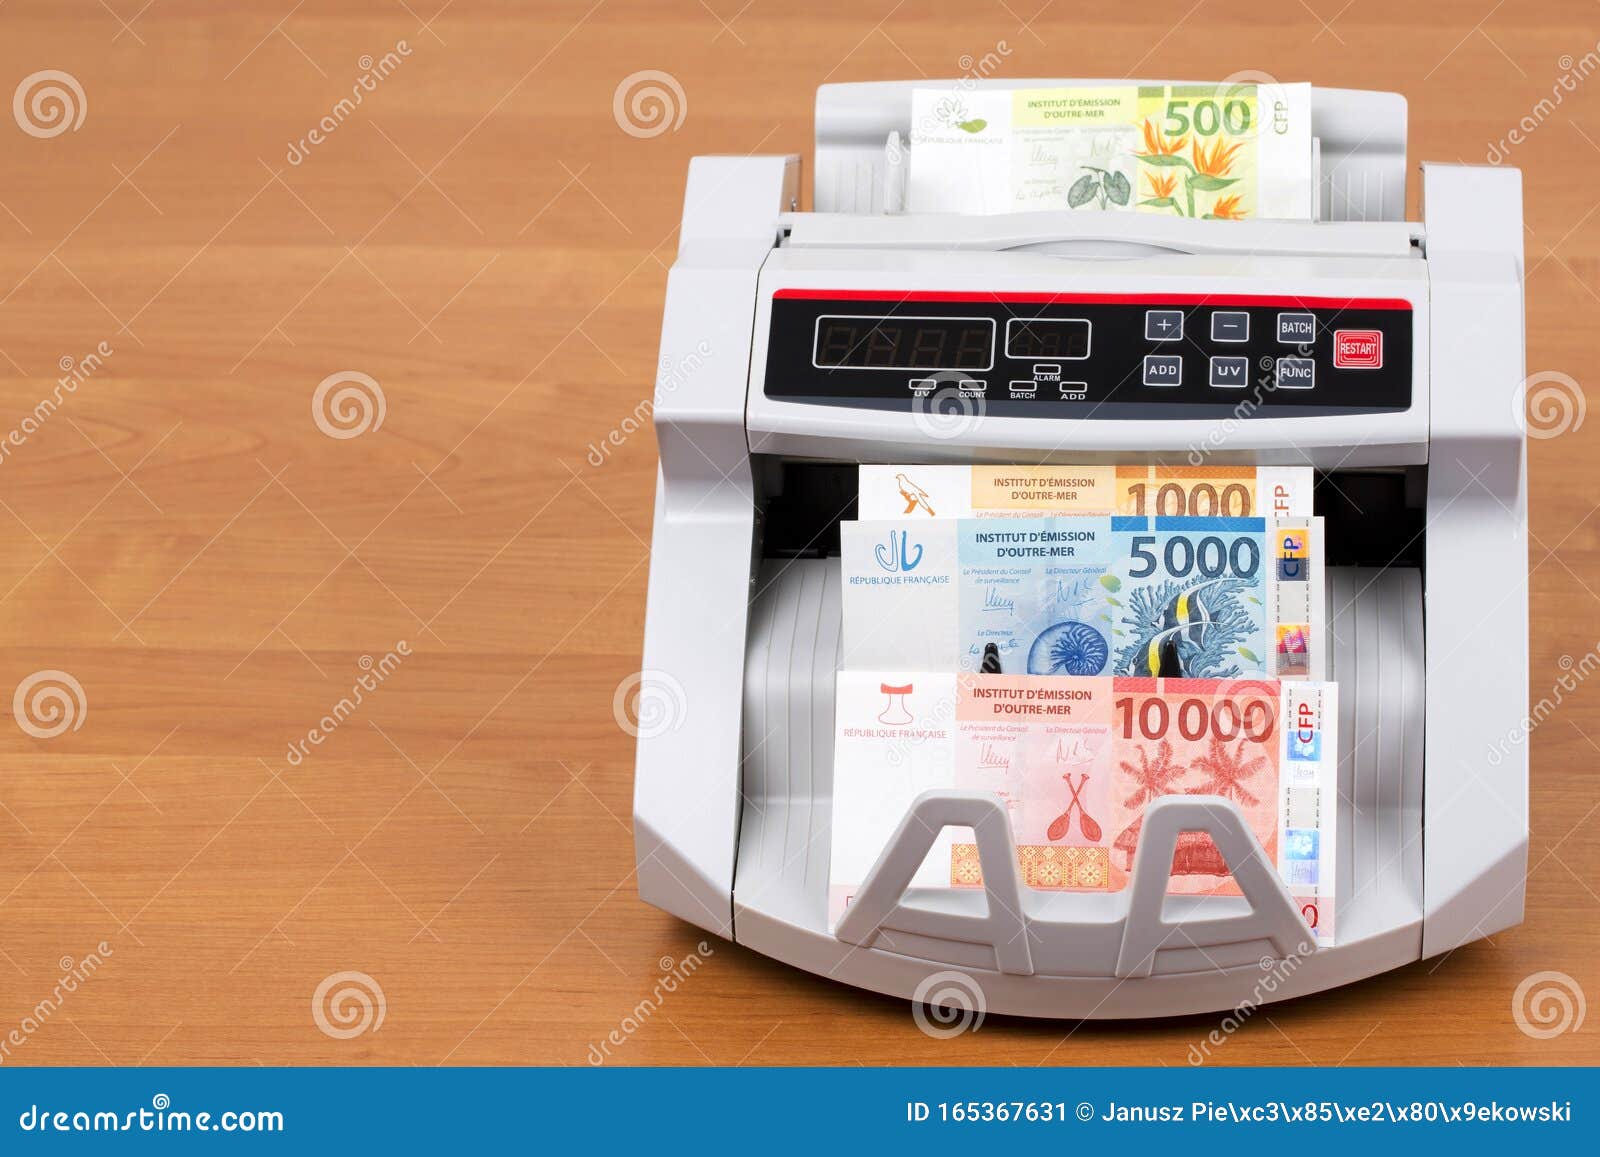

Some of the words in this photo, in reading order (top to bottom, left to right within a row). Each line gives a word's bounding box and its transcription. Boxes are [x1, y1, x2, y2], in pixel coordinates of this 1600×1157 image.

[1028, 99, 1066, 108] INSTITUT
[1068, 97, 1121, 108] D'ÉMISSION
[1044, 110, 1104, 120] D'OUTRE-MER
[1163, 99, 1252, 138] 500
[1274, 101, 1288, 135] CFP
[1281, 322, 1312, 334] BATCH
[1340, 342, 1377, 355] RESTART
[1149, 365, 1177, 376] ADD
[1217, 366, 1241, 377] UV
[1280, 367, 1312, 378] FUNC
[1033, 374, 1061, 382] ALARM
[959, 391, 986, 399] COUNT
[994, 478, 1037, 488] INSTITUT
[1039, 477, 1095, 488] D'ÉMISSION
[1011, 491, 1078, 501] D'OUTRE-MER
[1127, 482, 1251, 516] 1000
[976, 532, 1026, 544] INSTITUT
[1029, 530, 1096, 543] D'ÉMISSION
[997, 546, 1075, 557] D'OUTRE-MER
[1283, 537, 1299, 577] CFP
[849, 574, 902, 585] RÉPUBLIQUE
[904, 574, 950, 586] FRANÇAISE
[973, 687, 1024, 699] INSTITUT
[1027, 687, 1092, 701] D'ÉMISSION
[993, 703, 1071, 715] D'OUTRE-MER
[1298, 703, 1313, 743] CFP
[843, 728, 897, 738] RÉPUBLIQUE
[899, 728, 947, 740] FRANÇAISE
